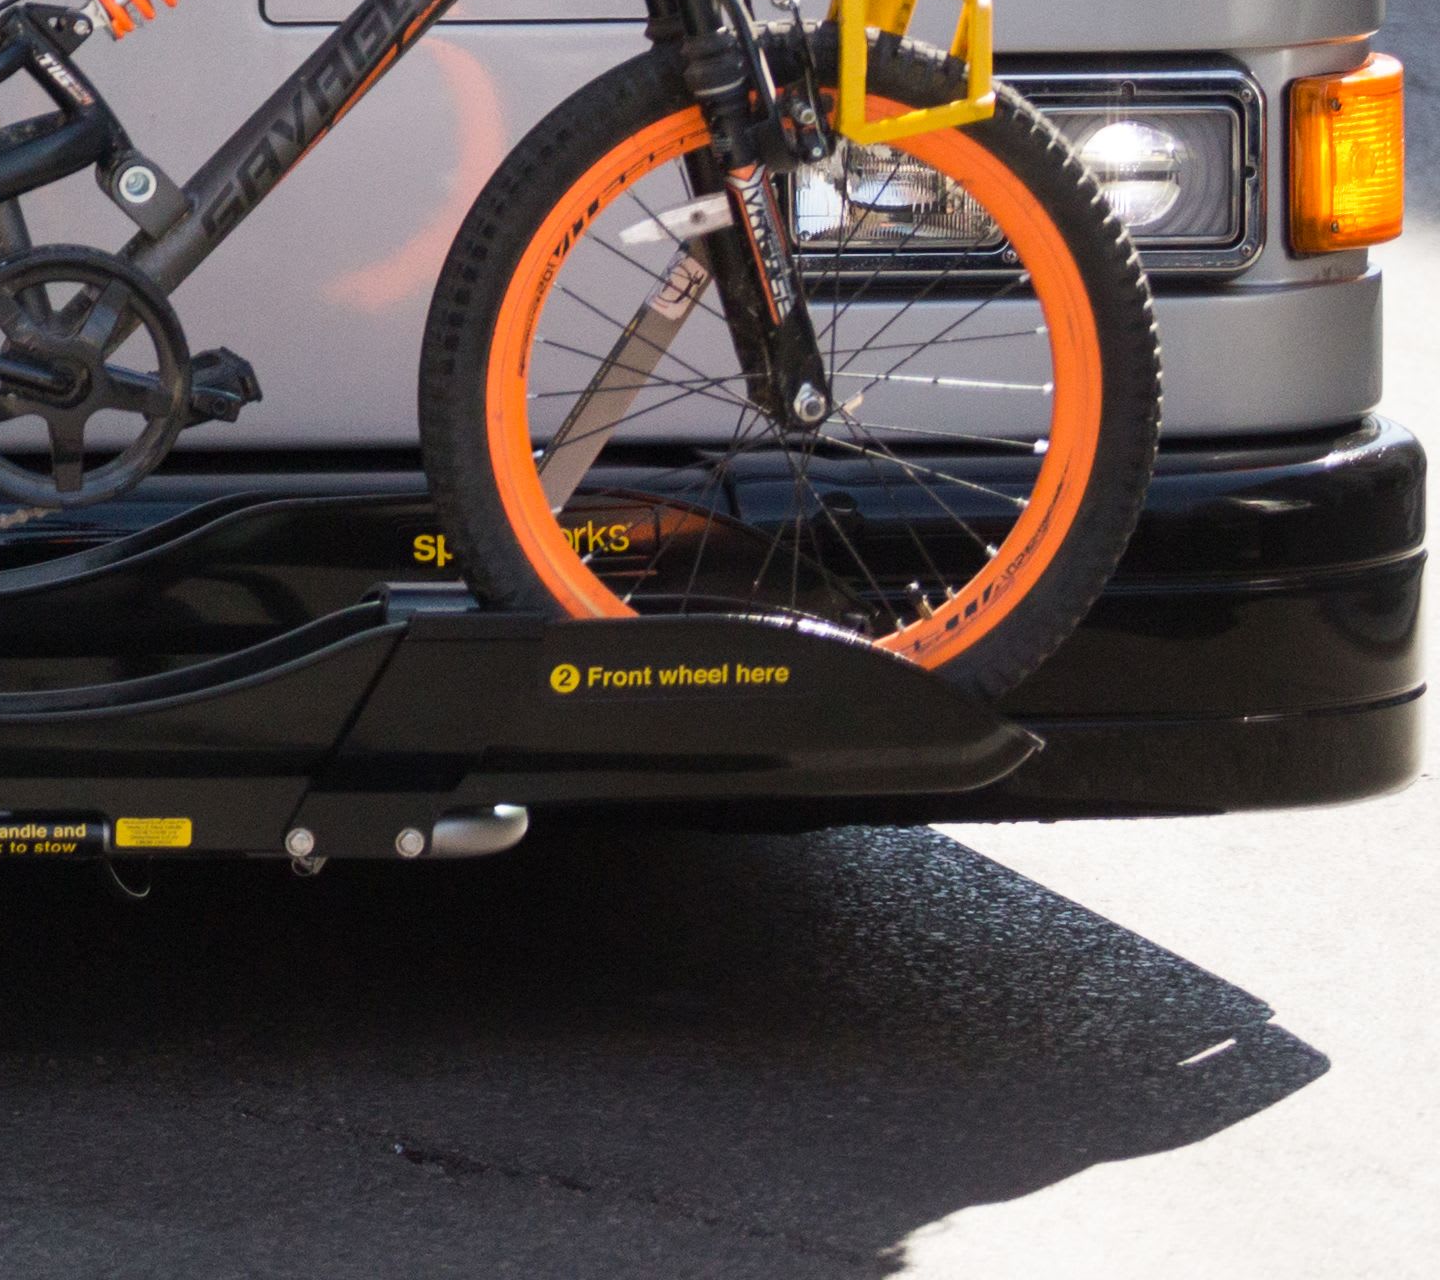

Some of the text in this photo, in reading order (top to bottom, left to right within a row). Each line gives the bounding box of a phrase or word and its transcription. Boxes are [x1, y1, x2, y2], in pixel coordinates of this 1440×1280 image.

[586, 665, 653, 688] Front
[658, 663, 728, 685] wheel
[735, 663, 790, 684] here
[52, 822, 88, 839] and
[9, 840, 27, 854] to
[33, 840, 78, 854] stow
